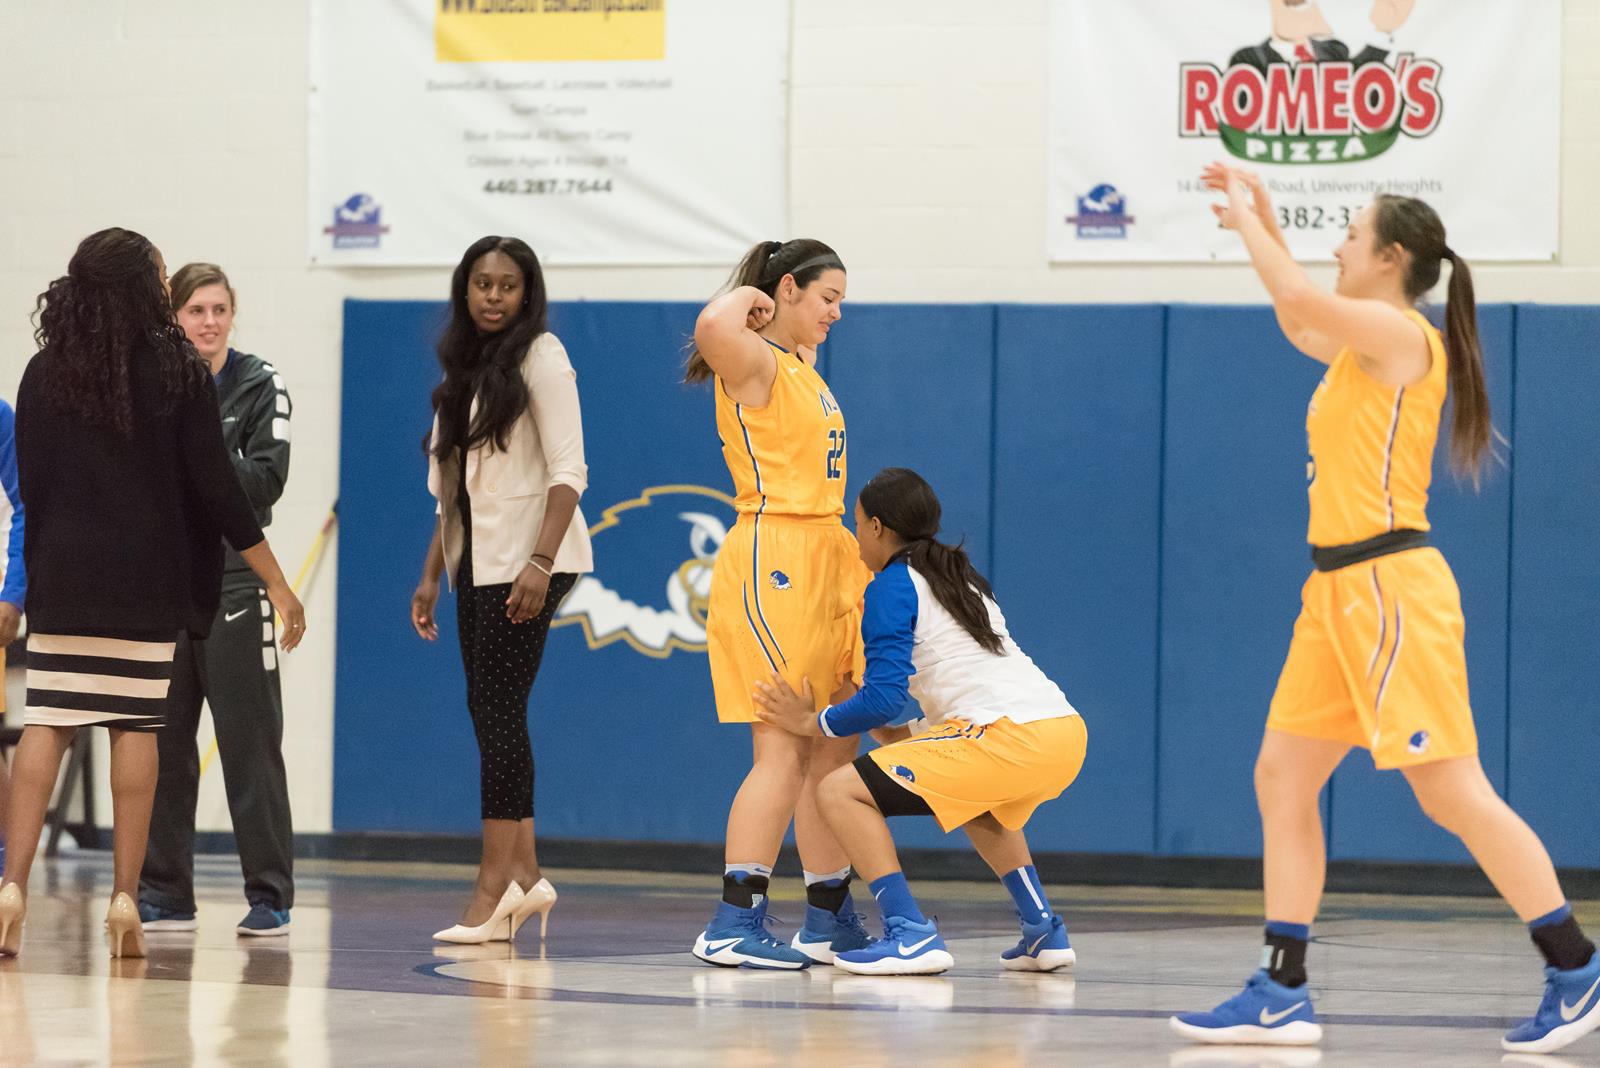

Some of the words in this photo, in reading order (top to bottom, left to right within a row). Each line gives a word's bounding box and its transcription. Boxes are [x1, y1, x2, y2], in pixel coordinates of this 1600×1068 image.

[1181, 53, 1442, 137] ROMEO'S
[1246, 137, 1366, 162] PIZZA
[1268, 179, 1308, 194] Road,
[1388, 178, 1443, 195] Heights
[827, 430, 846, 481] 22
